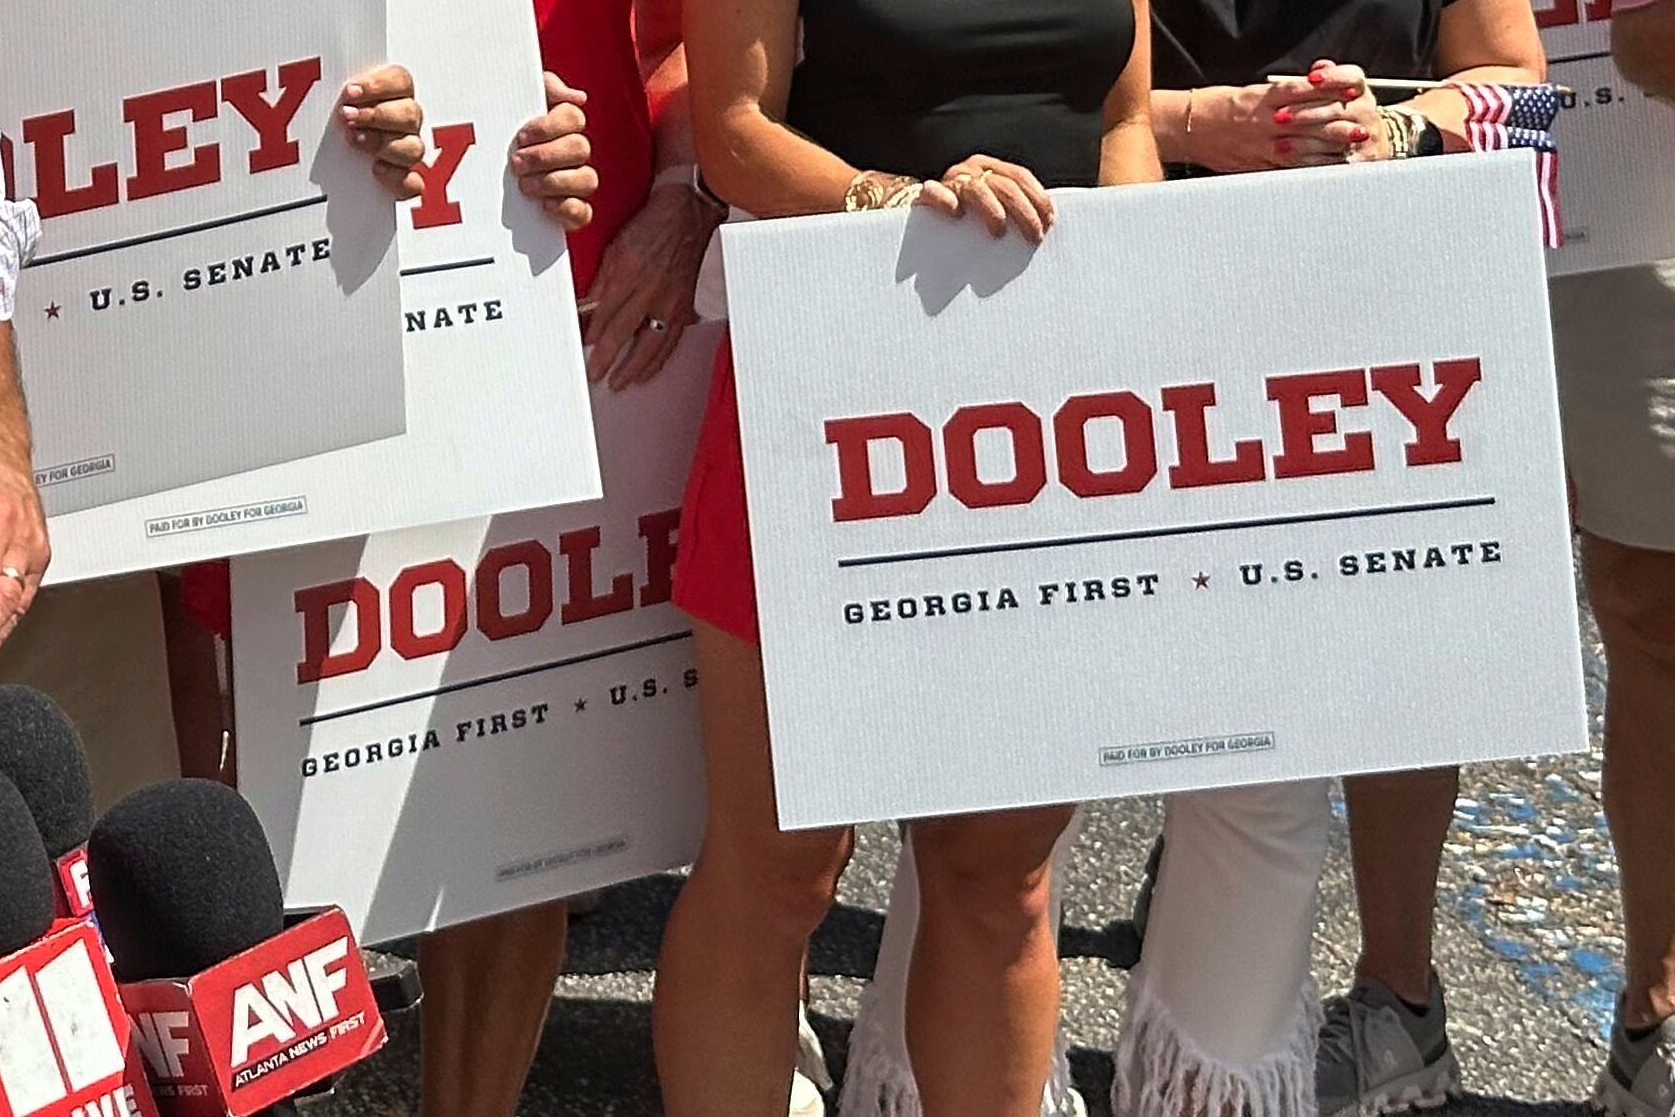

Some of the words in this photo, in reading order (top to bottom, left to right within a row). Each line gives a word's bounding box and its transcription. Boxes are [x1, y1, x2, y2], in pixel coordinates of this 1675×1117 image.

[1, 56, 322, 220] LEY
[90, 280, 164, 312] U.S.
[183, 238, 332, 291] SENATE
[70, 459, 111, 477] GEORGIA
[822, 356, 1483, 524] DOOLEY
[172, 517, 190, 530] FOR
[192, 515, 204, 527] BY
[206, 510, 242, 525] DOOLEY
[243, 506, 262, 519] FOR
[263, 500, 303, 516] GEORGIA
[843, 589, 1019, 625] GEORGIA
[1038, 574, 1160, 607] FIRST
[1239, 560, 1319, 587] U.S.
[1339, 541, 1504, 577] SENATE
[301, 728, 441, 778] GEORGIA
[456, 703, 549, 742] FIRST
[609, 677, 668, 707] U.S.
[1127, 748, 1148, 759] FOR
[1164, 743, 1203, 757] DOOLEY
[1205, 740, 1225, 752] FOR
[1227, 736, 1271, 750] GEORGIA
[230, 936, 349, 1068] ANF
[129, 1011, 189, 1078] NF
[235, 1052, 288, 1087] ATLANTA
[289, 1031, 327, 1059] NEWS
[329, 1011, 365, 1039] FIRST
